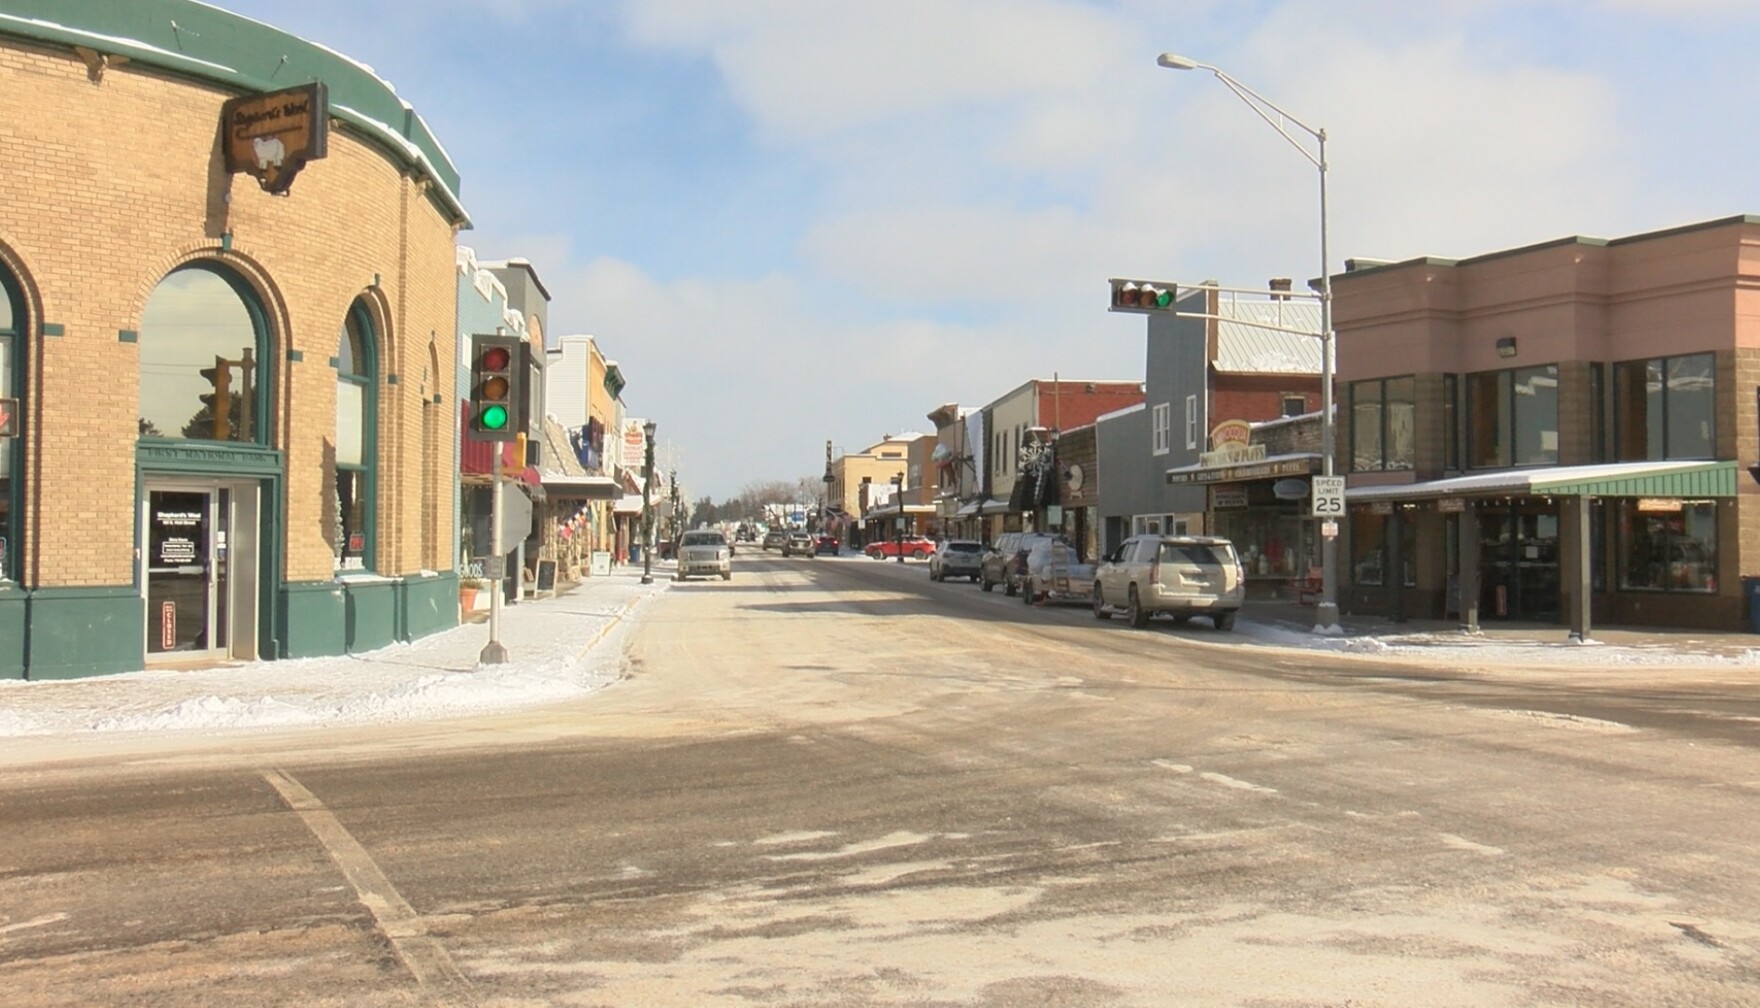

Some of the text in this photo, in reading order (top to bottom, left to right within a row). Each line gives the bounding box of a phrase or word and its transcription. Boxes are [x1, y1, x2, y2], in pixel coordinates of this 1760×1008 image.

[148, 447, 178, 458] FIRST
[185, 449, 235, 460] NATIONAL
[1316, 497, 1341, 512] 25
